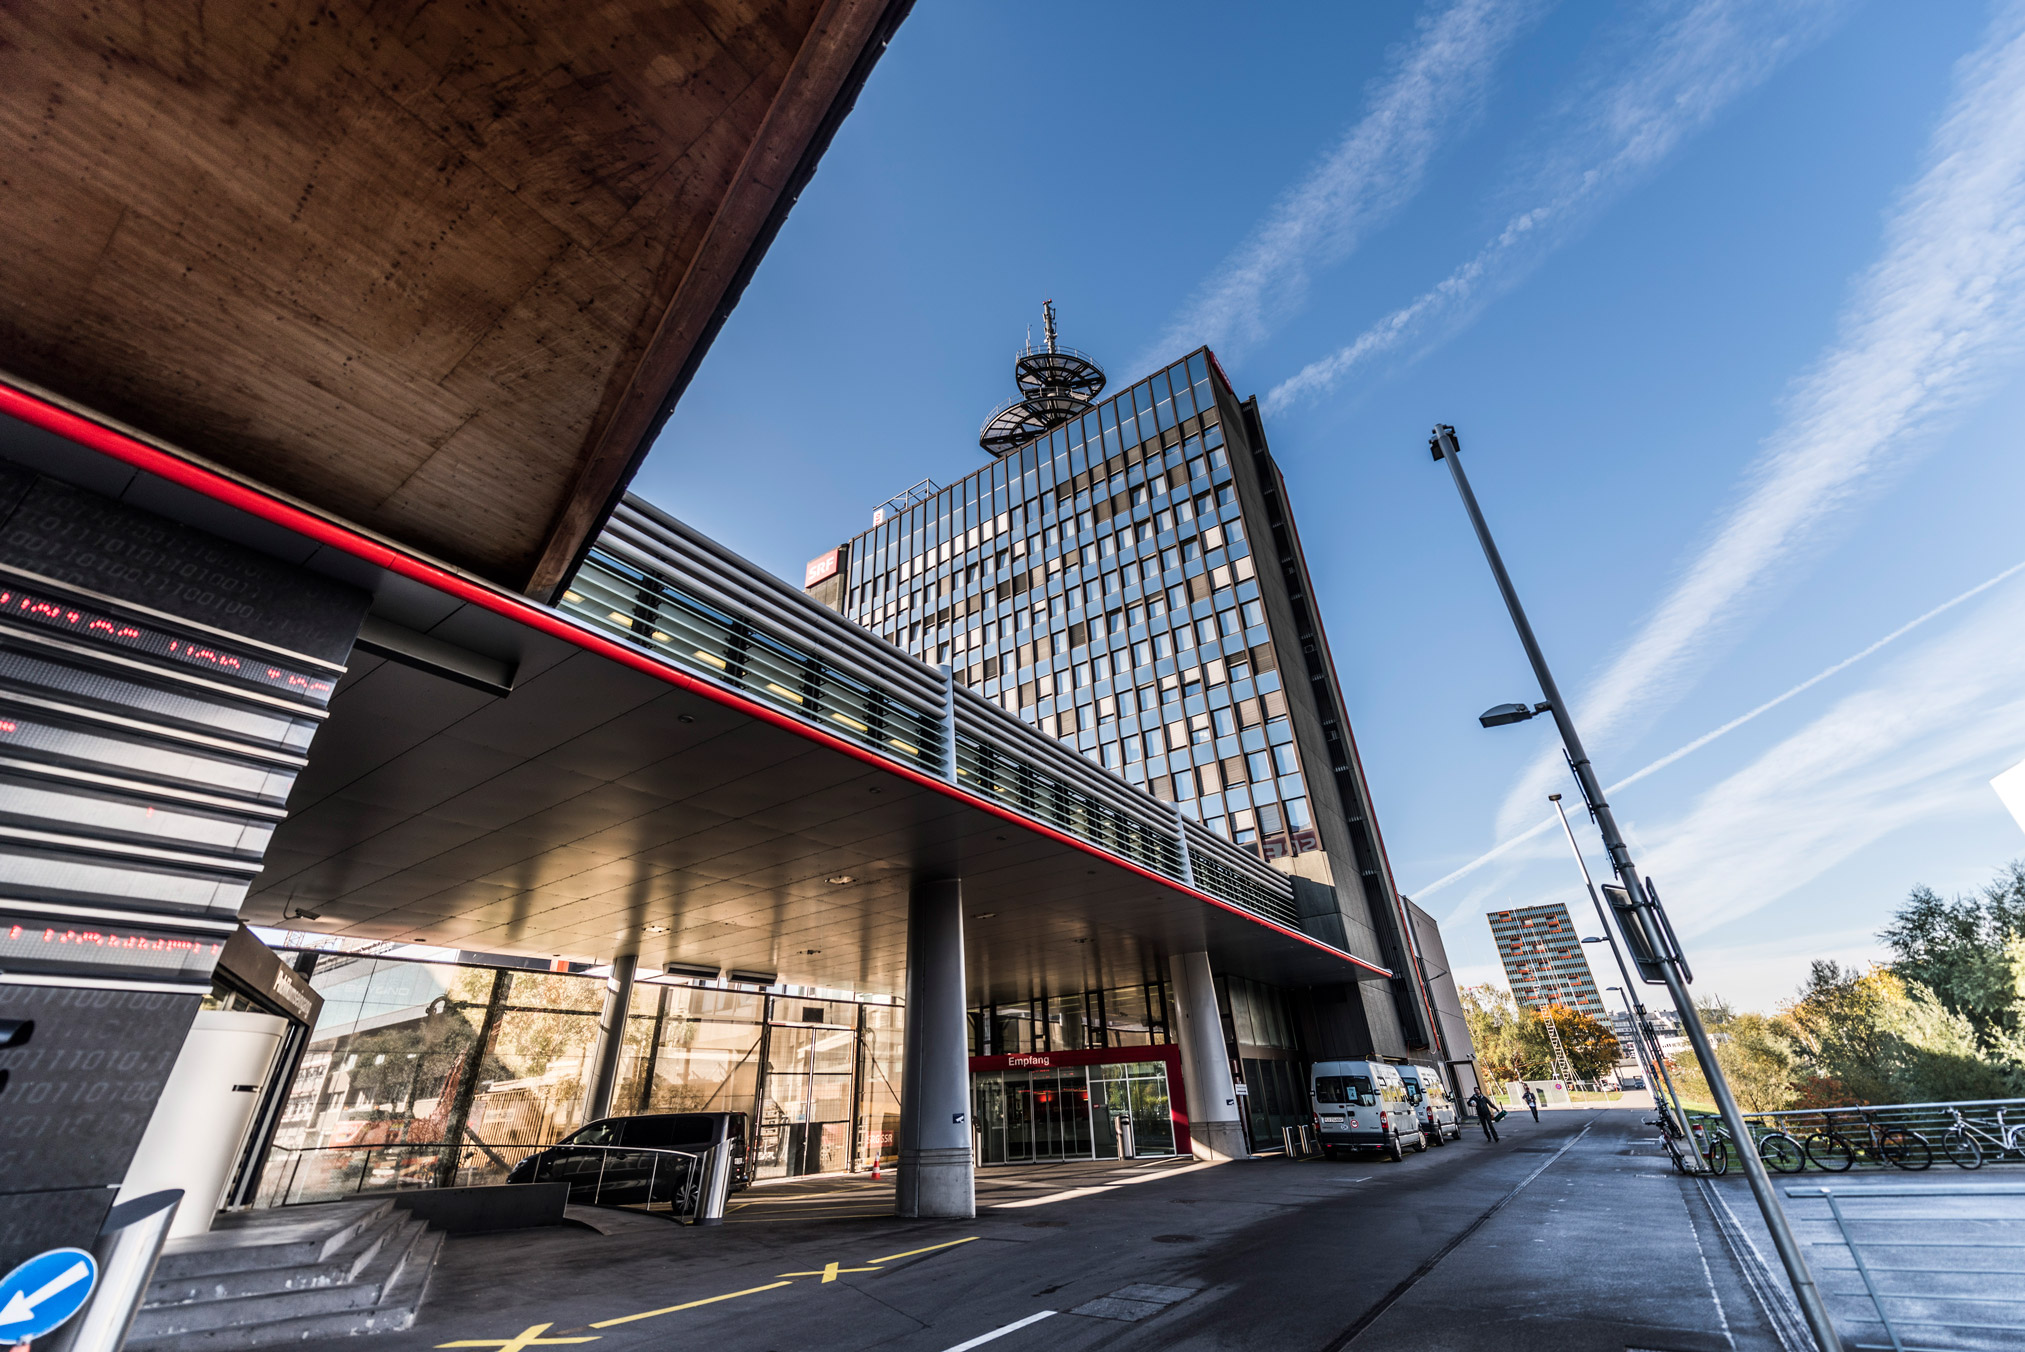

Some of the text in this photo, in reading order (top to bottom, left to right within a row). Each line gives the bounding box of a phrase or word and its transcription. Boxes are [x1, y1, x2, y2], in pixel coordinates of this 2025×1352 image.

[808, 555, 835, 581] SRF
[1008, 1055, 1050, 1067] Empfang
[881, 1133, 893, 1143] SSR
